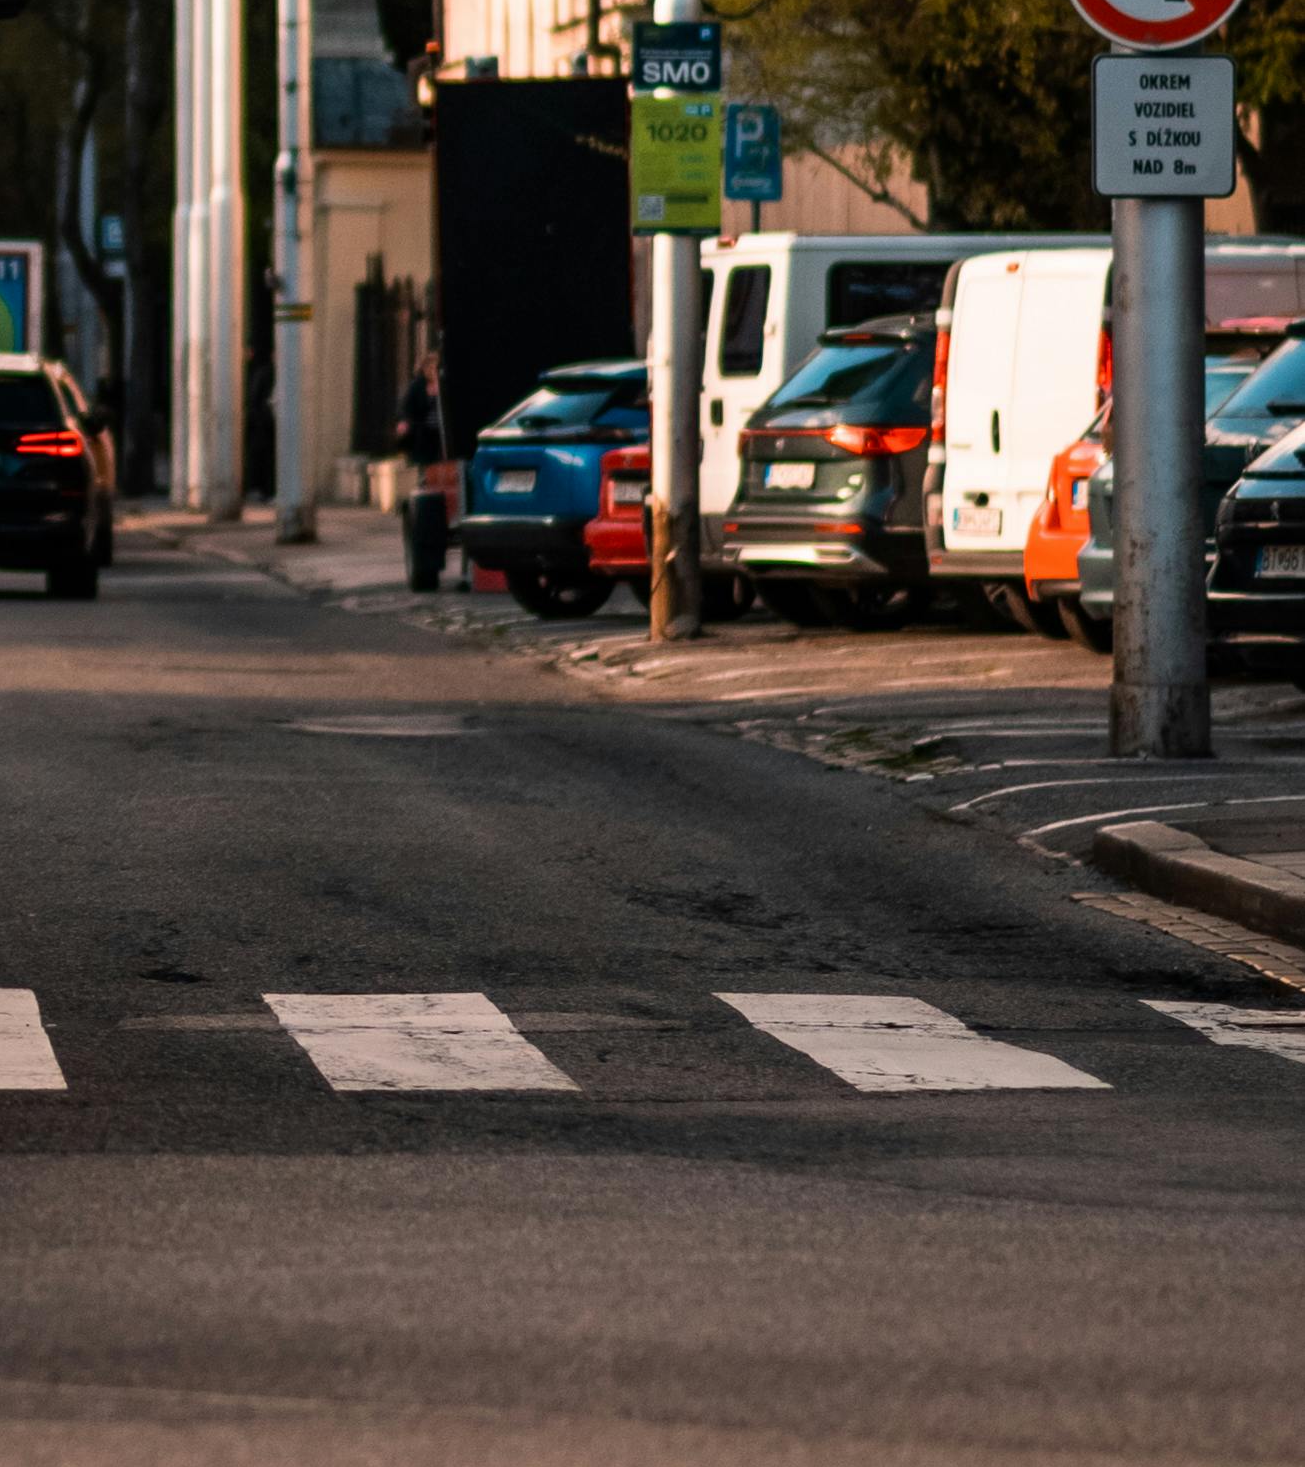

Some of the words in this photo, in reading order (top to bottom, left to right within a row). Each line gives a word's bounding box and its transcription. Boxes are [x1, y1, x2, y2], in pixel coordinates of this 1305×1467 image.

[1140, 74, 1191, 90] OKREM
[1134, 101, 1196, 118] VOZIDIEL
[647, 123, 708, 143] 1020
[1128, 130, 1137, 147] S
[1133, 159, 1164, 175] NAD
[1174, 159, 1197, 175] 8m
